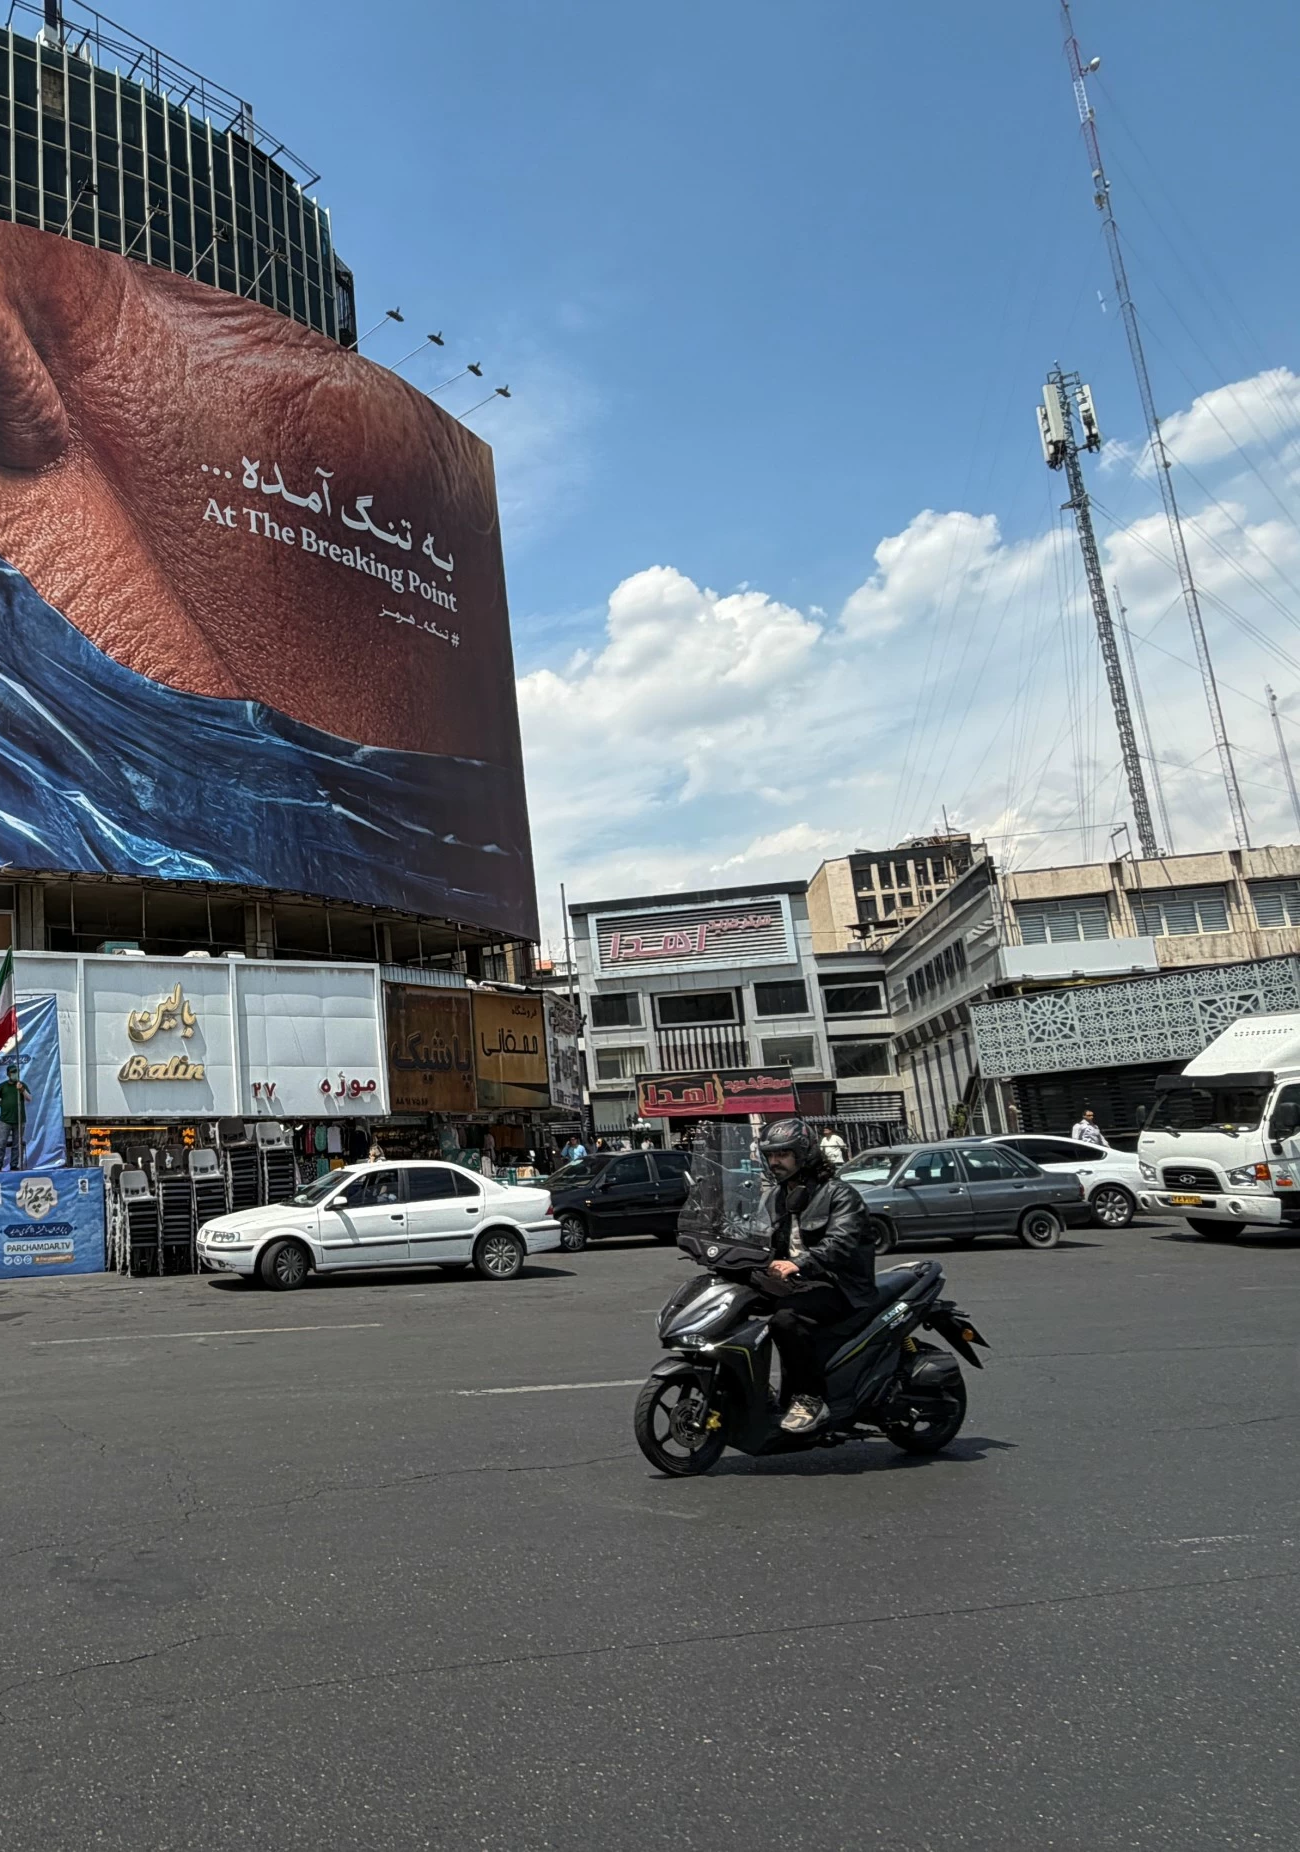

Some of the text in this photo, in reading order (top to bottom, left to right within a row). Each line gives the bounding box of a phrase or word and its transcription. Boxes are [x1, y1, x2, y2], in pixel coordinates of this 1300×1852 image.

[202, 498, 458, 613] At The Breaking Point
[118, 1055, 205, 1082] Balin
